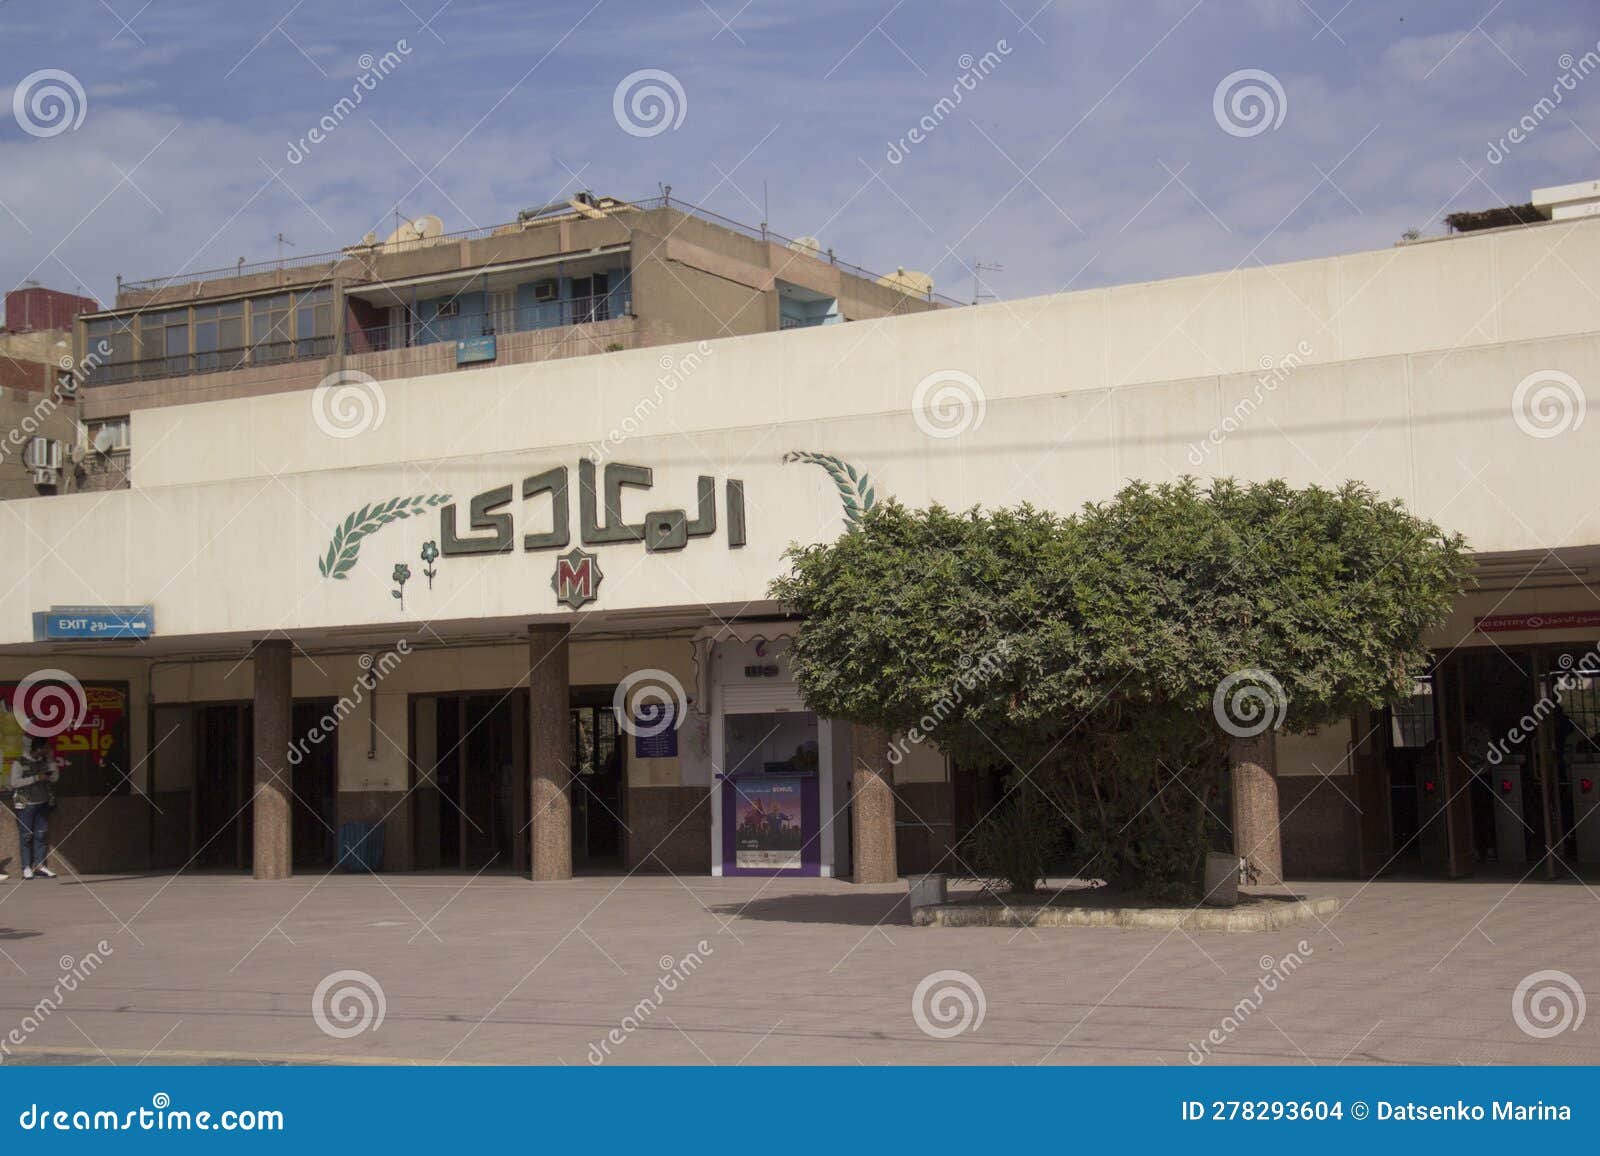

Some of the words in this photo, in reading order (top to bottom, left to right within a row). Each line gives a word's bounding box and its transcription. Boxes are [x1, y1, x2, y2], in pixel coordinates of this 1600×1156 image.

[558, 558, 591, 598] M
[58, 619, 88, 630] EXIT
[1493, 618, 1525, 627] ENTRY
